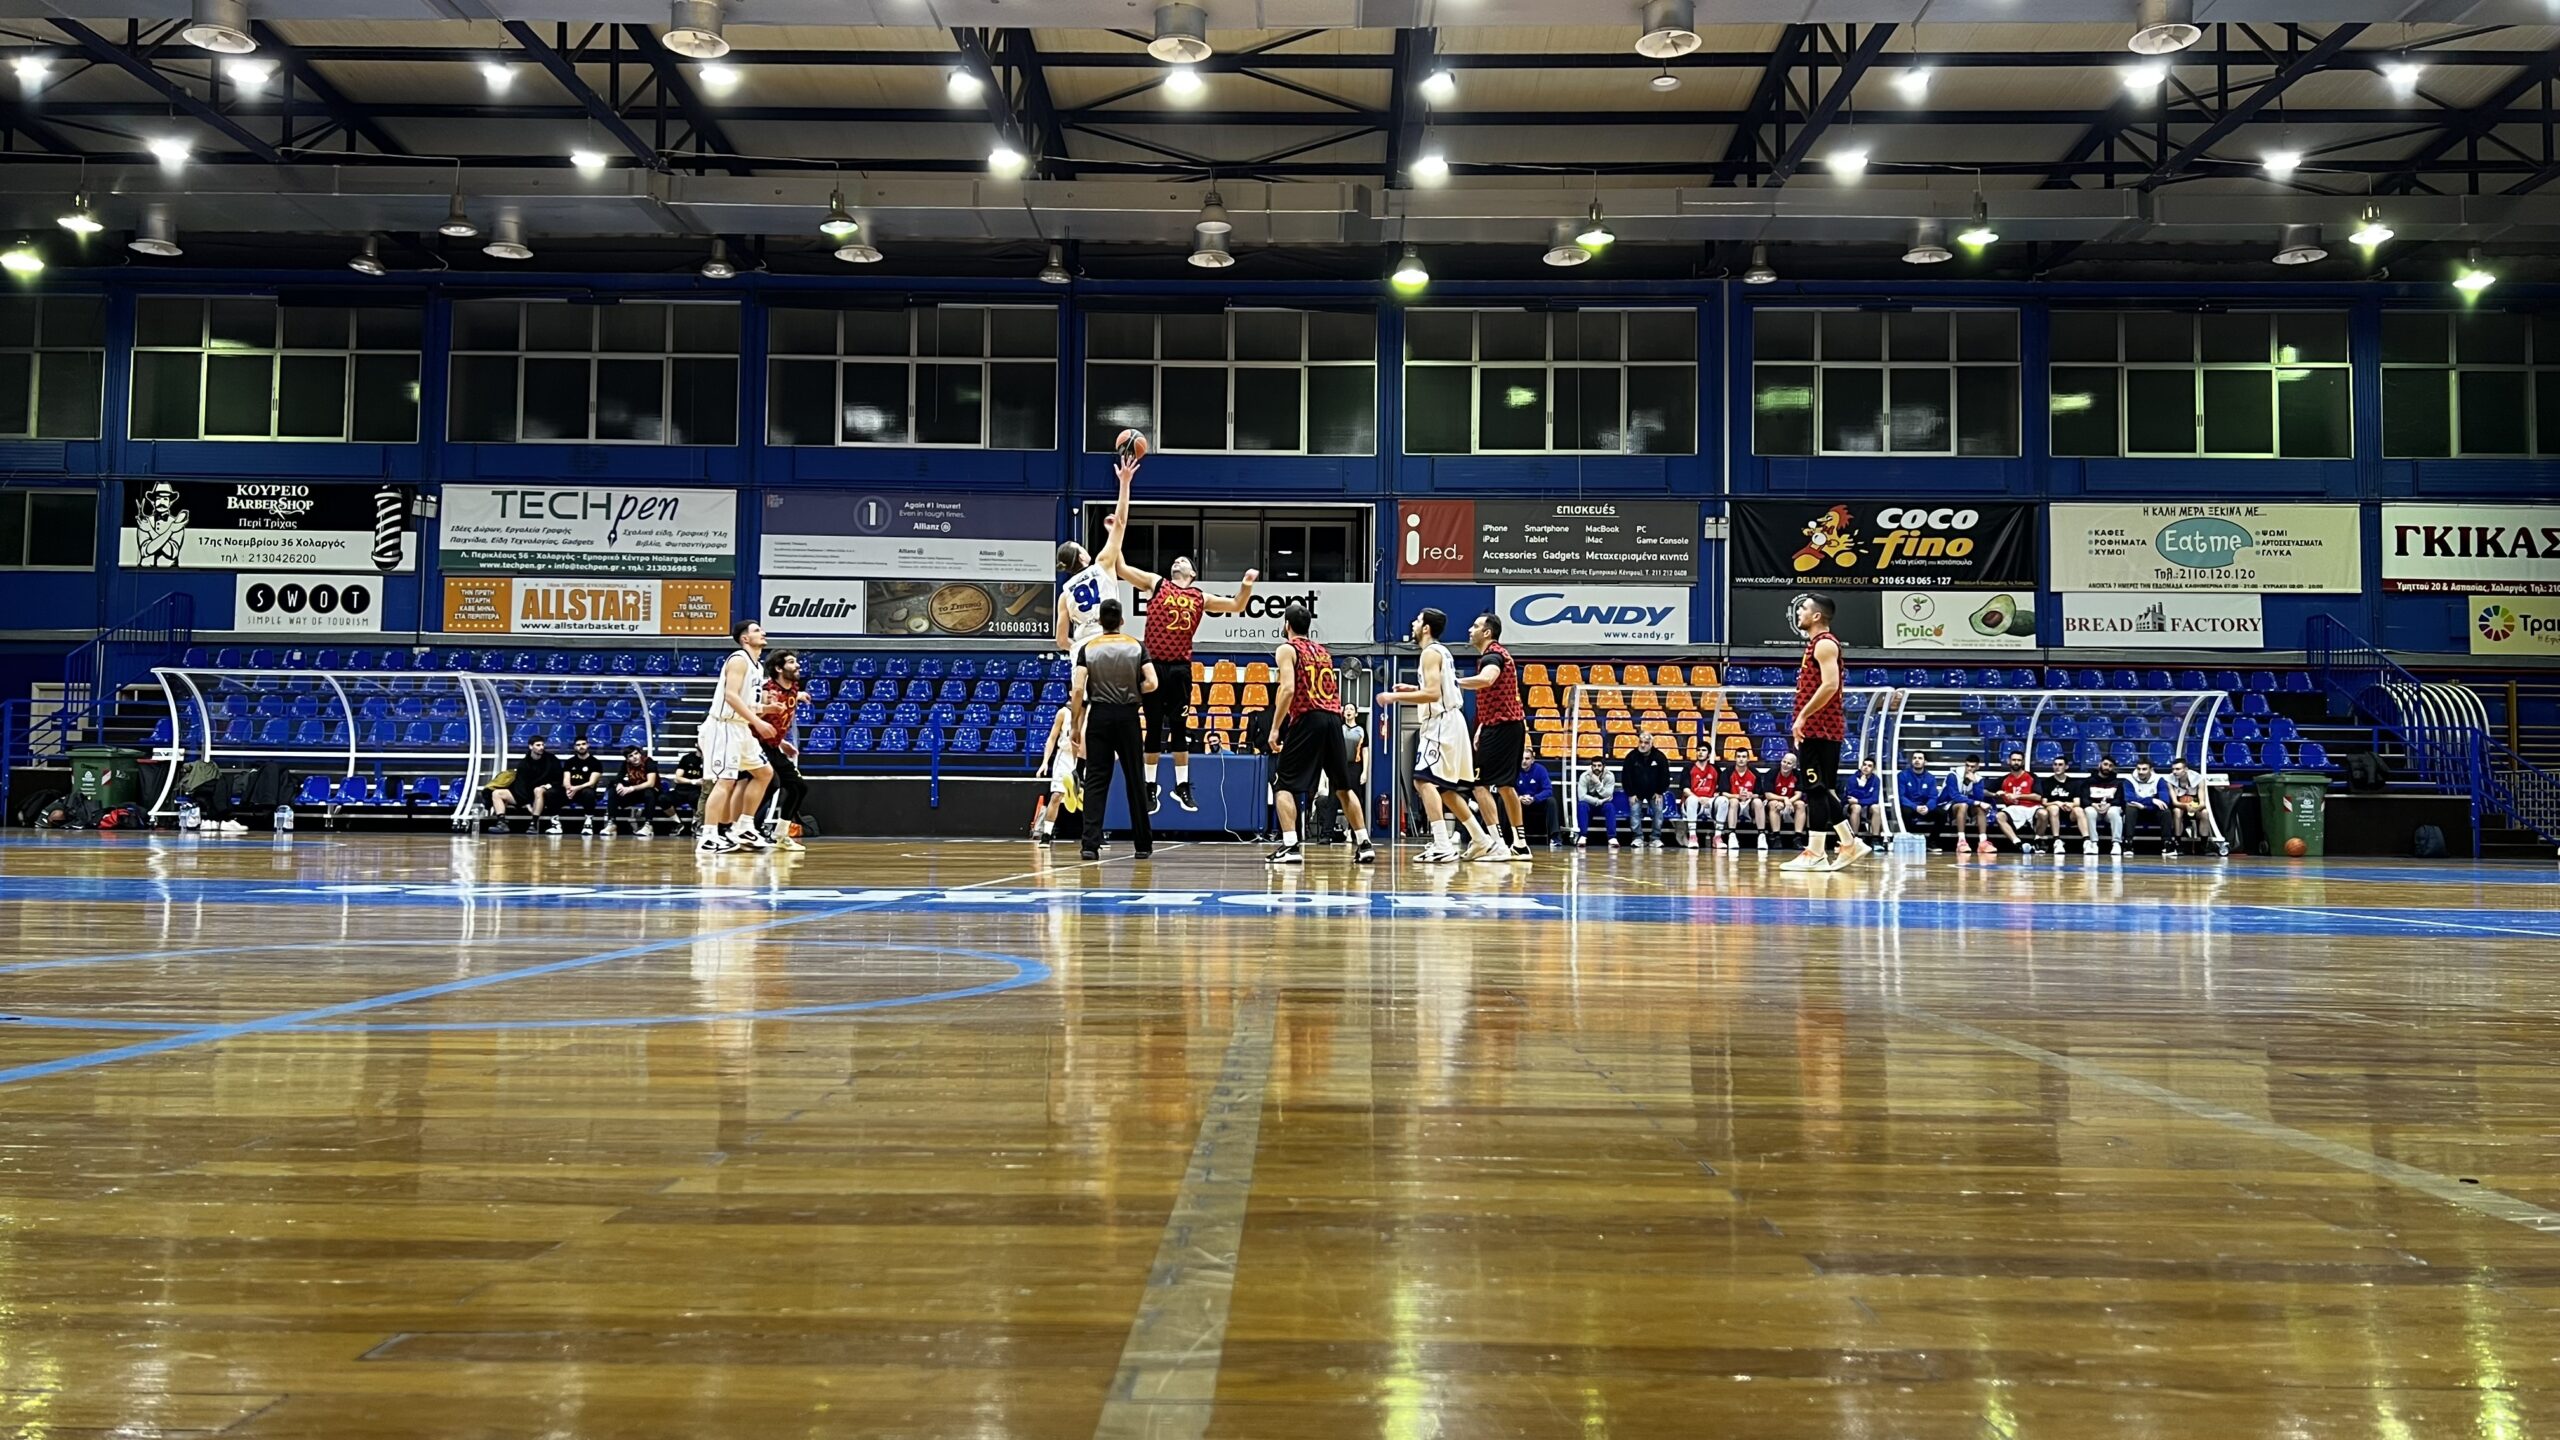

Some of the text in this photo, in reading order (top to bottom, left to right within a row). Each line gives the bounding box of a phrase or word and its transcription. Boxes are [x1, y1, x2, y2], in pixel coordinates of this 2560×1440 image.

[236, 484, 309, 496] ΚΟΥΡΕΙΟ
[904, 502, 926, 510] Again
[924, 510, 945, 519] tough
[2143, 507, 2149, 516] Η
[2152, 507, 2176, 516] ΚΑΛΗ
[2179, 507, 2205, 516] ΜΕΡΑ
[2208, 507, 2242, 517] ΞΕΚΙΝΑ
[239, 518, 297, 529] Περί Τρίχας
[913, 522, 940, 531] Allianz
[1482, 524, 1647, 534] iPhone Smartphone MacBook PC
[450, 525, 472, 533] Ιδέες
[505, 526, 540, 534] Εργαλεία
[2094, 529, 2125, 537] ΚΑΦΕΣ
[198, 537, 221, 546] 17ης
[224, 537, 279, 548] Νοεμβρίου
[295, 538, 346, 549] Χολαργός
[562, 538, 594, 546] Gadgets
[1482, 535, 1689, 545] iPad Tablet iMac Game Console
[2094, 538, 2147, 546] ΡΟΦΗΜΑΤΑ
[2261, 539, 2323, 547] ΑΡΤΟΣΚΕΥΑΣΜΑΤΑ
[2394, 525, 2560, 559] ΓΚΙΚΑΣ
[1872, 530, 1975, 570] fino
[2094, 548, 2126, 556] ΧΥΜΟΙ
[221, 553, 316, 563] τηλ 2130426200
[471, 552, 517, 560] Περικλέους
[536, 553, 575, 561] Χολαργός
[582, 553, 620, 561] Εμπορικό
[621, 554, 650, 562] Κέντρο
[651, 555, 688, 563] Holargos
[1482, 550, 1689, 562] Accessories Gadgets Μεταχειρισμένα κινητά
[479, 562, 546, 570] www.techpen.gr
[554, 563, 620, 572] info@techpen.gr
[1735, 576, 1794, 586] www.cocofino.gr
[1879, 576, 1895, 585] 210
[1894, 576, 1905, 585] 65
[1905, 577, 1916, 585] 43
[1916, 577, 1932, 585] 065
[1937, 576, 1952, 585] 127
[2396, 582, 2430, 592] Υμηττού
[2431, 582, 2441, 591] 20
[2441, 582, 2449, 591] &
[2491, 583, 2528, 594] Χολαργός
[2530, 583, 2548, 594] Τηλ:
[254, 588, 362, 610] SWOT
[1073, 578, 1101, 613] 91
[521, 589, 641, 621] ALLSTAR
[768, 595, 857, 618] Goldair
[247, 616, 369, 627] SIMPLE WAY OF TOURISM
[1166, 609, 1192, 631] 23
[2065, 617, 2263, 633] BREAD FACTORY
[521, 622, 640, 632] www.allstarbasket.gr
[988, 621, 1050, 633] 2106080313
[1225, 627, 1265, 638] urban
[1604, 630, 1676, 641] www.candy.gr
[1806, 768, 1818, 783] 5
[1780, 787, 1788, 796] 9
